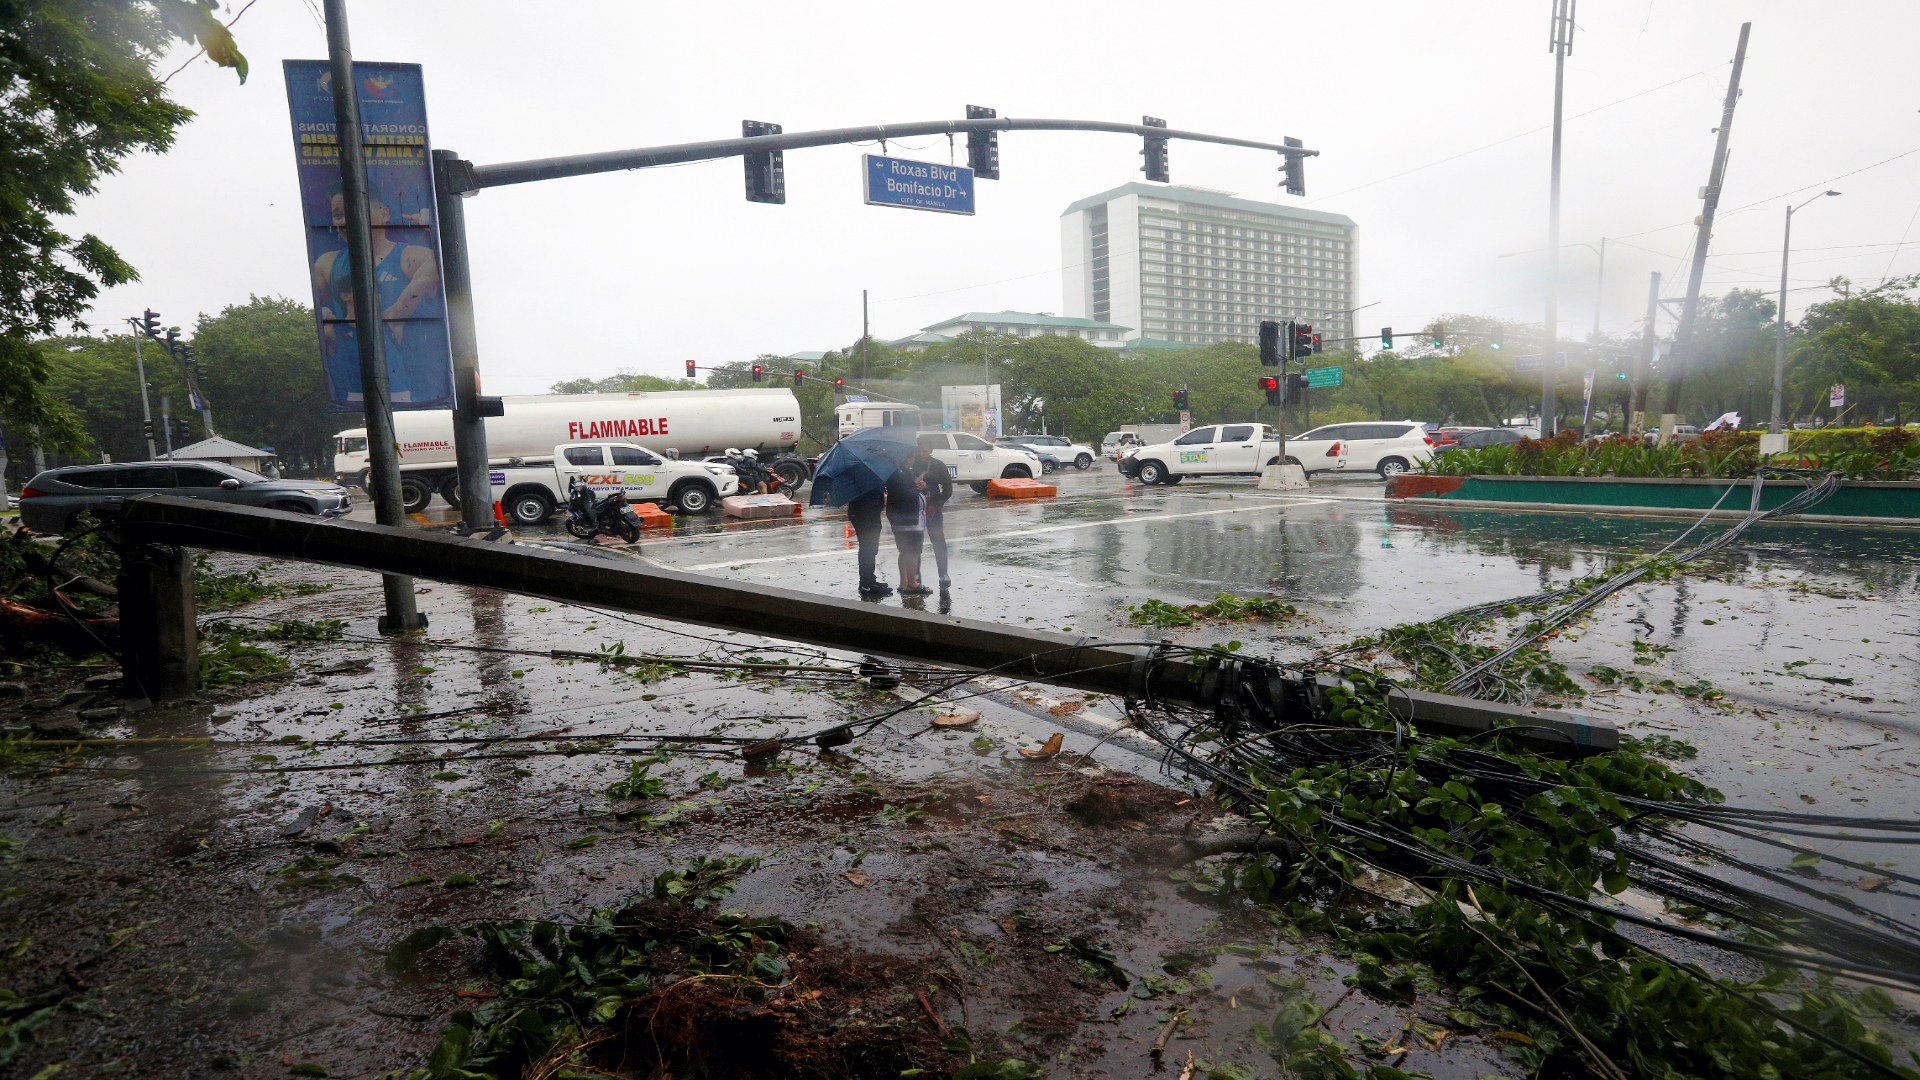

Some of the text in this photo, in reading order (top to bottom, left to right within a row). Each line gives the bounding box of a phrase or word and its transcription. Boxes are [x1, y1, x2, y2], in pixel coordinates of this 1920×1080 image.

[891, 160, 957, 181] Roxas Blvd
[887, 178, 957, 199] Bonifacio Dr
[568, 417, 669, 440] FLAMMABLE
[403, 440, 449, 449] FLAMMABLE
[1181, 453, 1208, 462] STAR
[623, 473, 655, 486] 558
